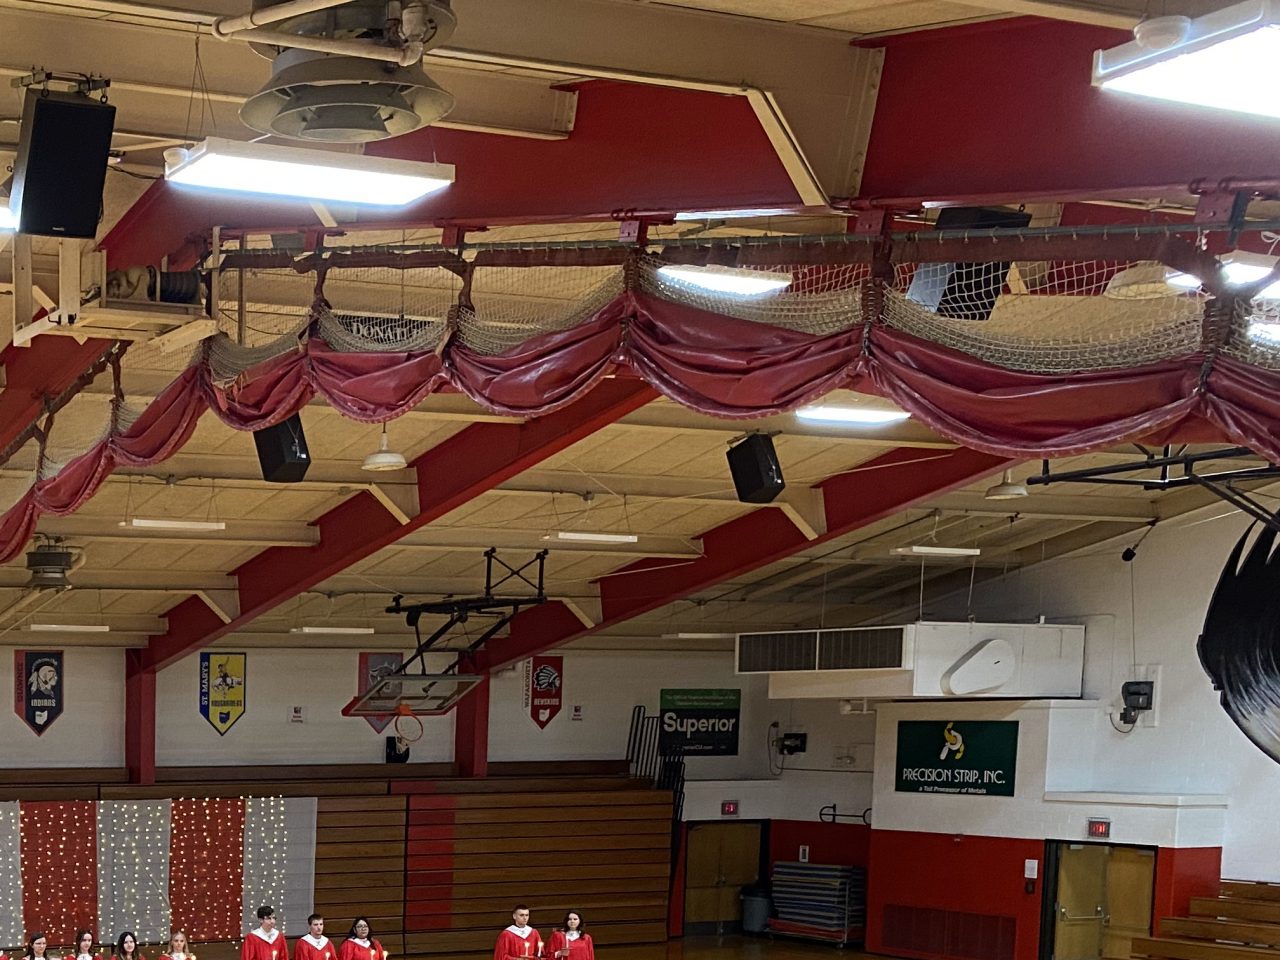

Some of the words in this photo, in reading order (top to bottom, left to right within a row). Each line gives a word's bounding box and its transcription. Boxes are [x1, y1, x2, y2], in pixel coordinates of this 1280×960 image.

[31, 699, 56, 707] INDIANS
[663, 712, 736, 739] Superior
[903, 768, 952, 782] PRECISION
[954, 769, 982, 784] STRIP,
[984, 770, 1006, 784] INC.
